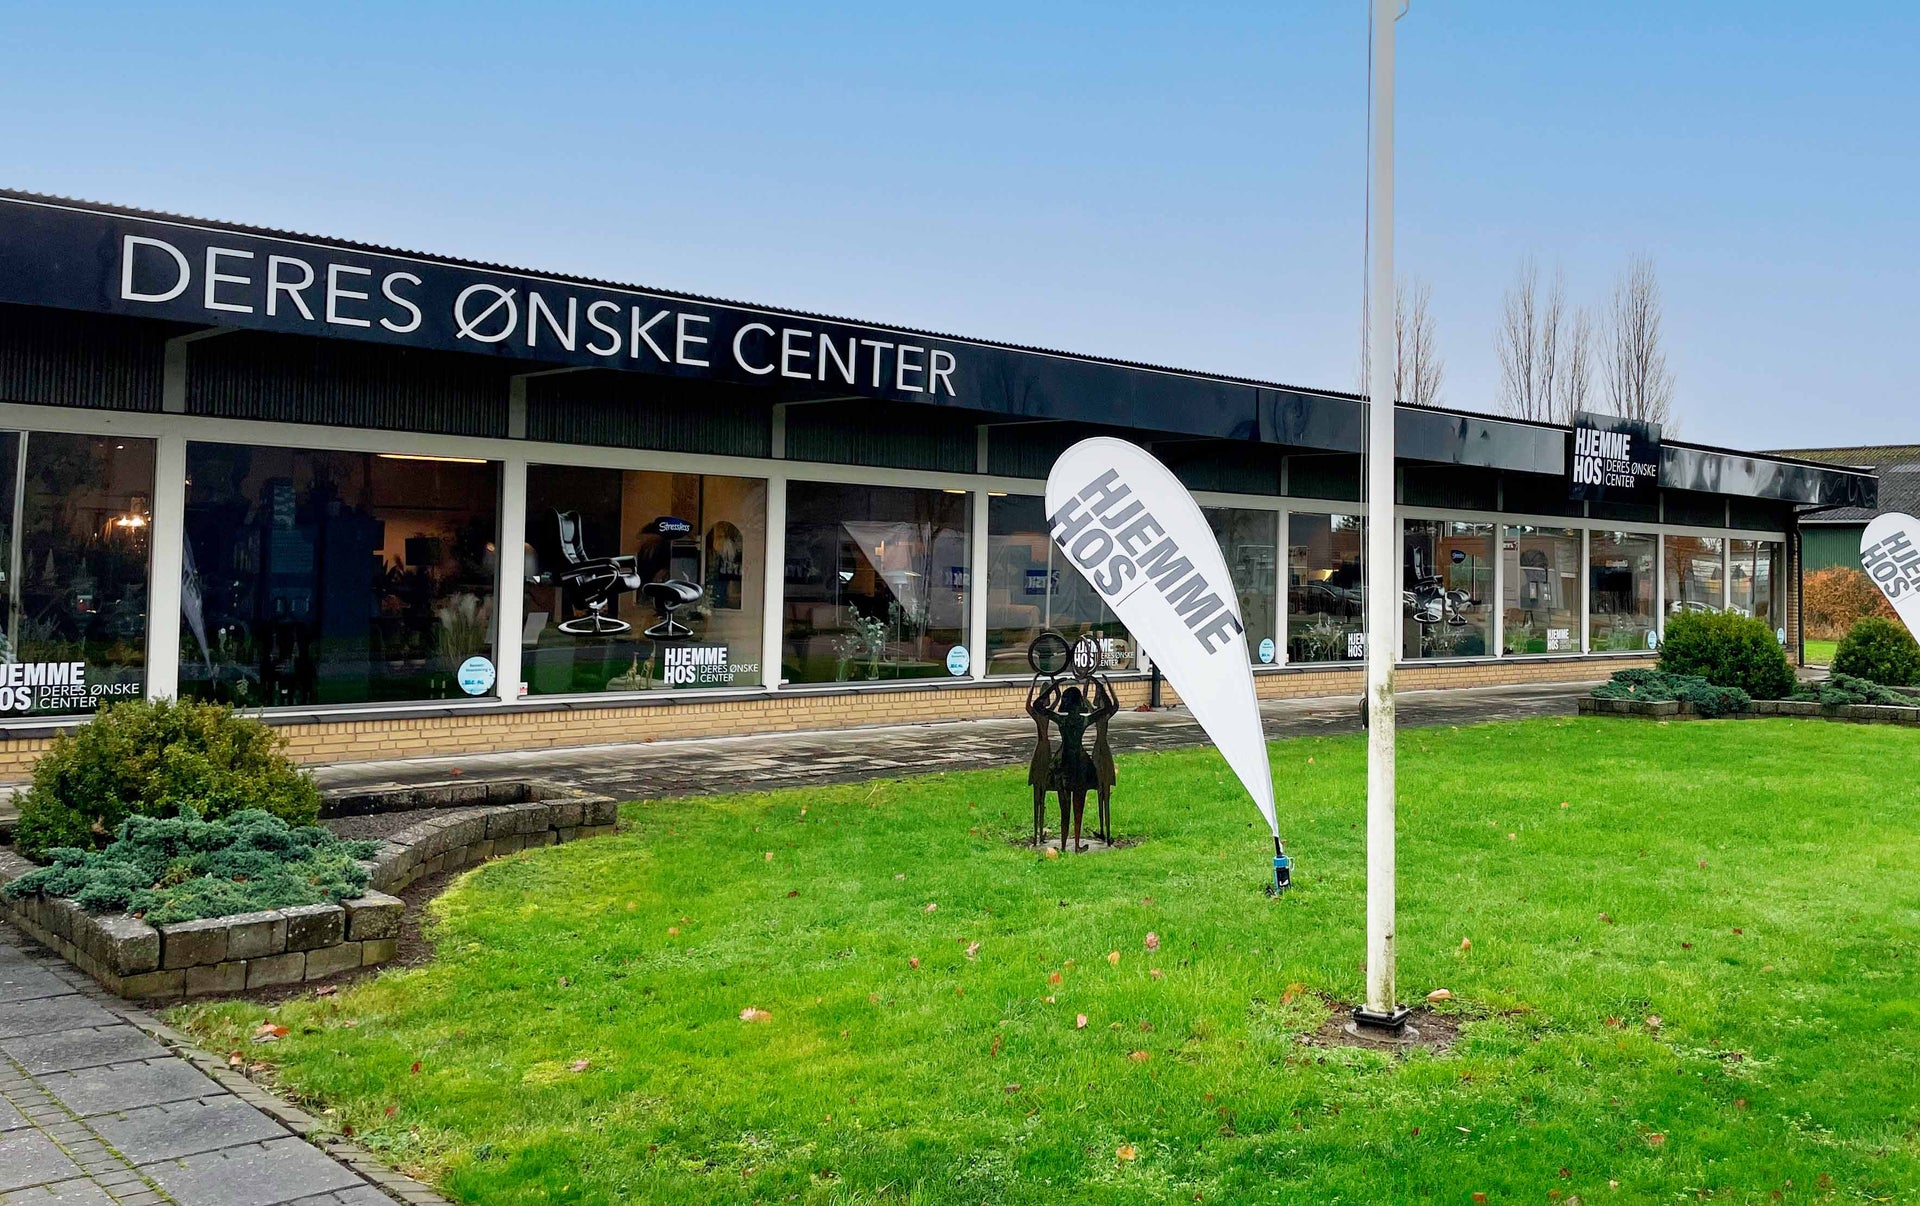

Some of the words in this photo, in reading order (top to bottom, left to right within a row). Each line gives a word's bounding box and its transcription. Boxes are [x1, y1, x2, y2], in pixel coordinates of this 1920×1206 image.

[120, 234, 423, 333] DERES
[453, 284, 711, 368] ØNSKE
[733, 322, 957, 397] CENTER
[1575, 427, 1631, 461] HJEMME
[1573, 455, 1602, 485] HOS
[1606, 459, 1630, 474] DERES
[1631, 462, 1657, 477] ØNSKE
[1605, 473, 1635, 488] CENTER
[1047, 496, 1137, 596] HOS
[1077, 468, 1243, 655] HJEMME
[1860, 543, 1910, 598] HOS
[1881, 531, 1920, 592] HJE
[664, 647, 727, 666] HJEMME
[1073, 652, 1095, 668] HOS
[1101, 652, 1115, 660] ERES
[1347, 644, 1363, 658] HOS
[700, 664, 728, 674] DERES
[729, 663, 759, 673] ØNSKE
[1099, 659, 1119, 667] ENTER
[0, 661, 86, 687] JEMME
[664, 665, 696, 684] HOS
[700, 673, 734, 683] CENTER
[0, 686, 32, 711] OS
[40, 685, 87, 697] DERES
[90, 683, 140, 696] ØNSKE
[39, 696, 97, 709] CENTER
